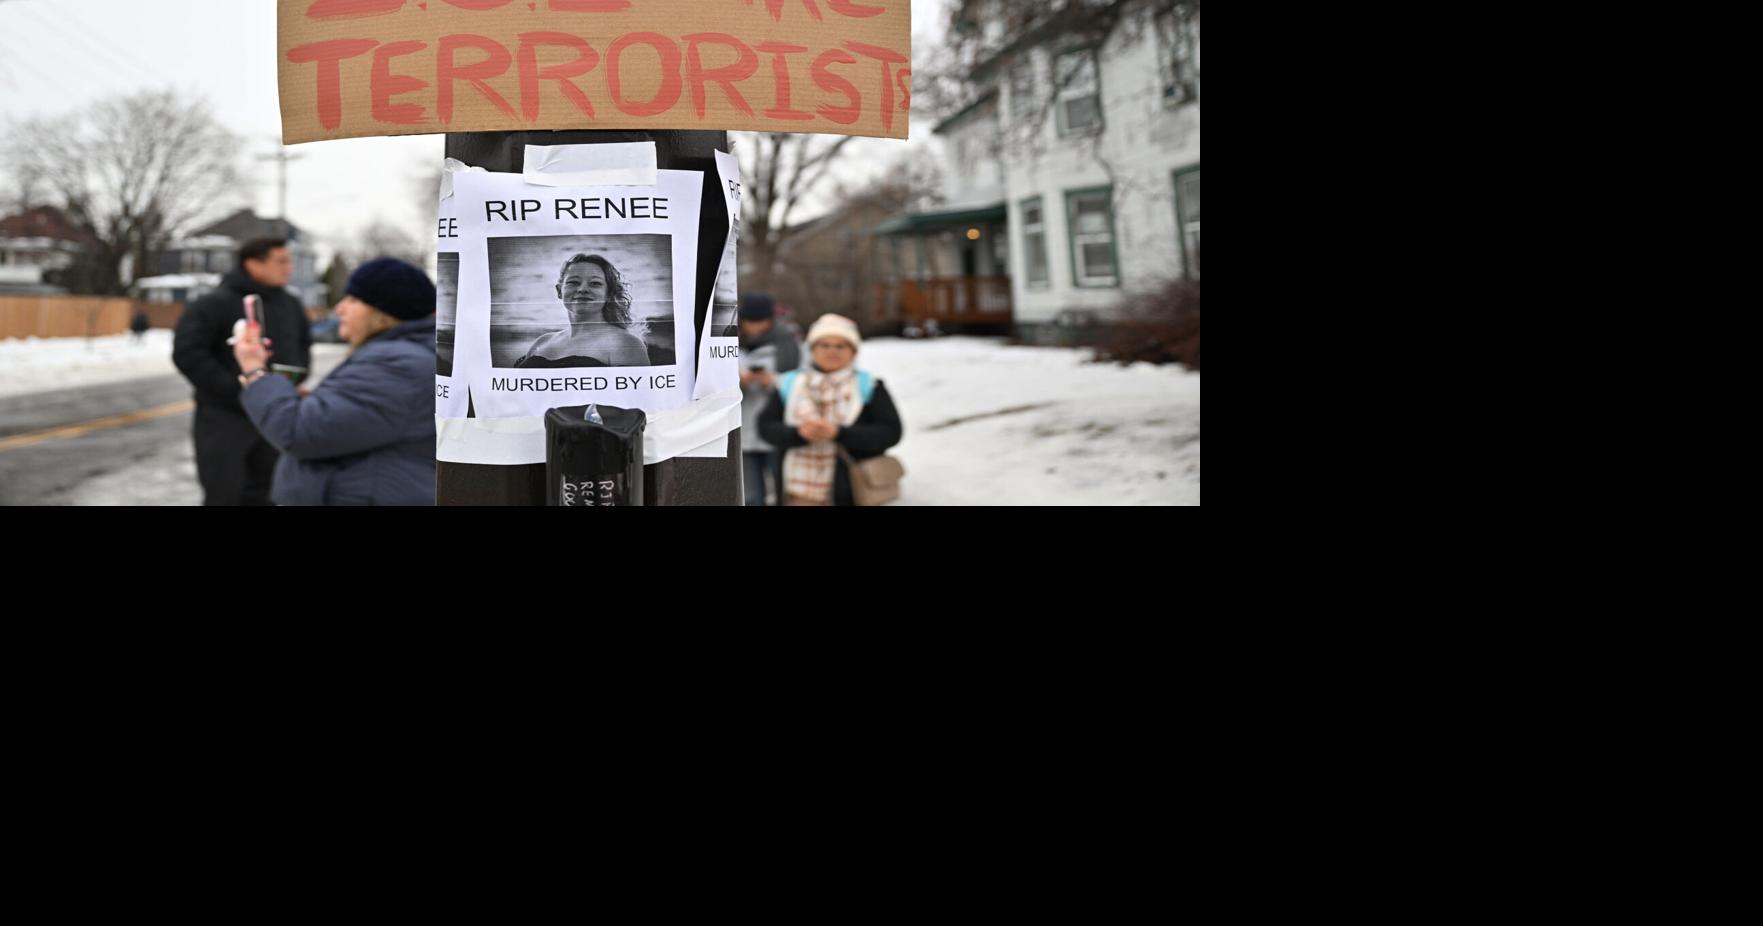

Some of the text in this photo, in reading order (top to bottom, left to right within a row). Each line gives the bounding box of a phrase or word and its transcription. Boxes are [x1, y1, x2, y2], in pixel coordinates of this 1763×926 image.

[485, 197, 669, 222] RIP RENEE
[491, 375, 676, 392] MURDERED BY ICE
